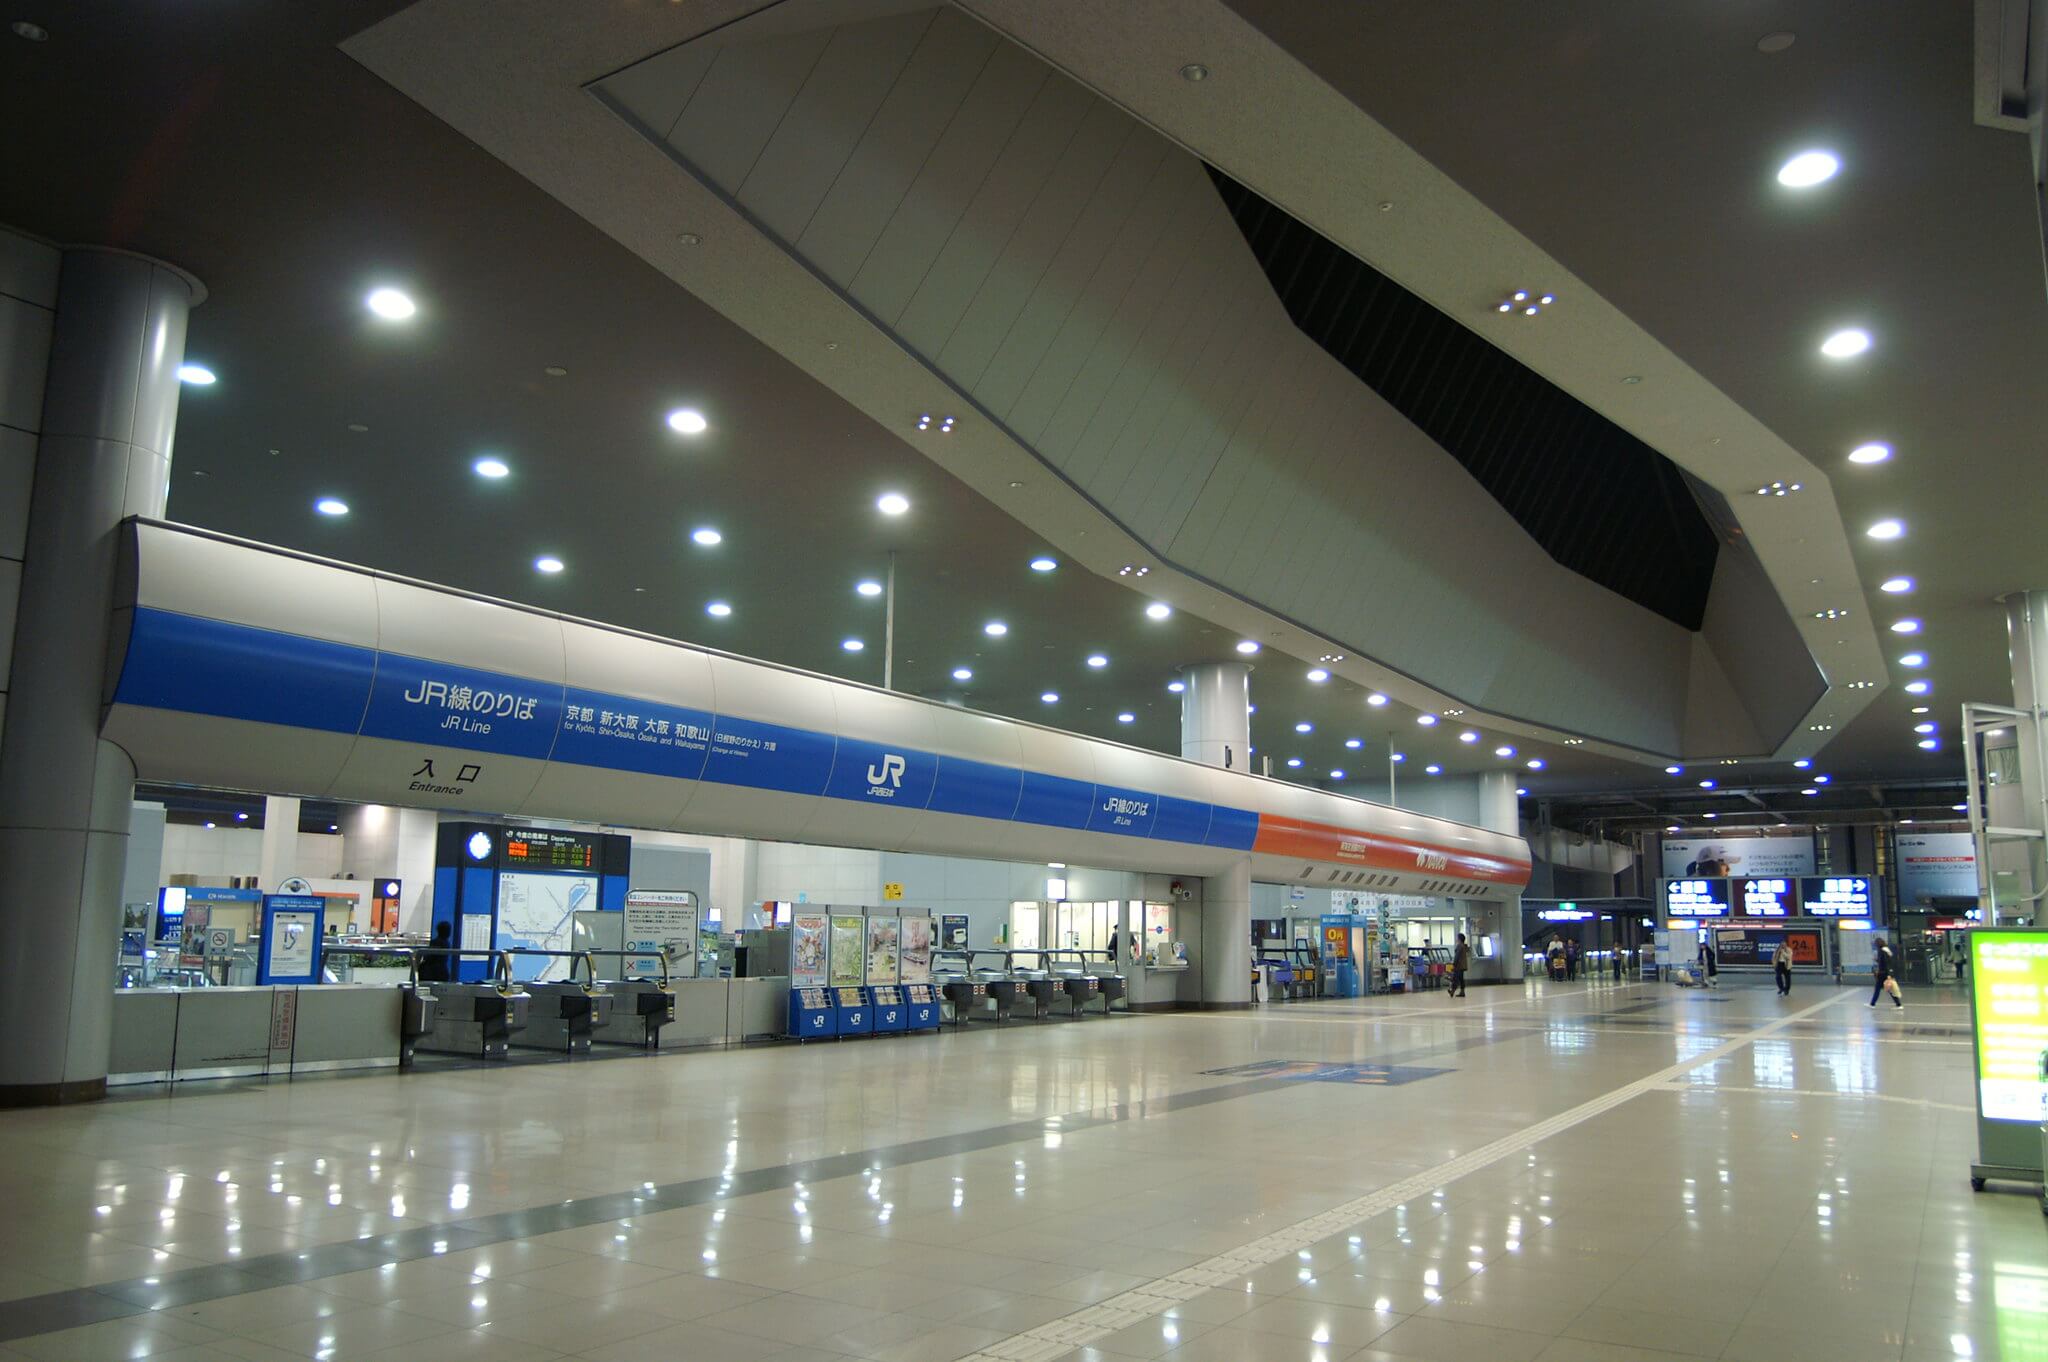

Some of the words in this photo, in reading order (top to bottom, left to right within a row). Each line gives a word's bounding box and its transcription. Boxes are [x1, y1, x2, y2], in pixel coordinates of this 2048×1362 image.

[404, 680, 538, 719] JR線のりば
[441, 715, 460, 730] JR
[463, 718, 491, 734] Line
[563, 721, 574, 730] for
[566, 705, 594, 723] 京都
[600, 710, 639, 730] 新大阪
[644, 718, 670, 735] 大阪
[674, 723, 710, 741] 和歌山
[413, 759, 481, 782] 入口
[867, 754, 906, 787] JR
[409, 781, 464, 795] Entrance
[1103, 797, 1149, 816] JR線のりば
[813, 1015, 824, 1025] JR
[850, 1013, 861, 1022] JR
[886, 1011, 896, 1021] JR
[920, 1009, 929, 1018] JR
